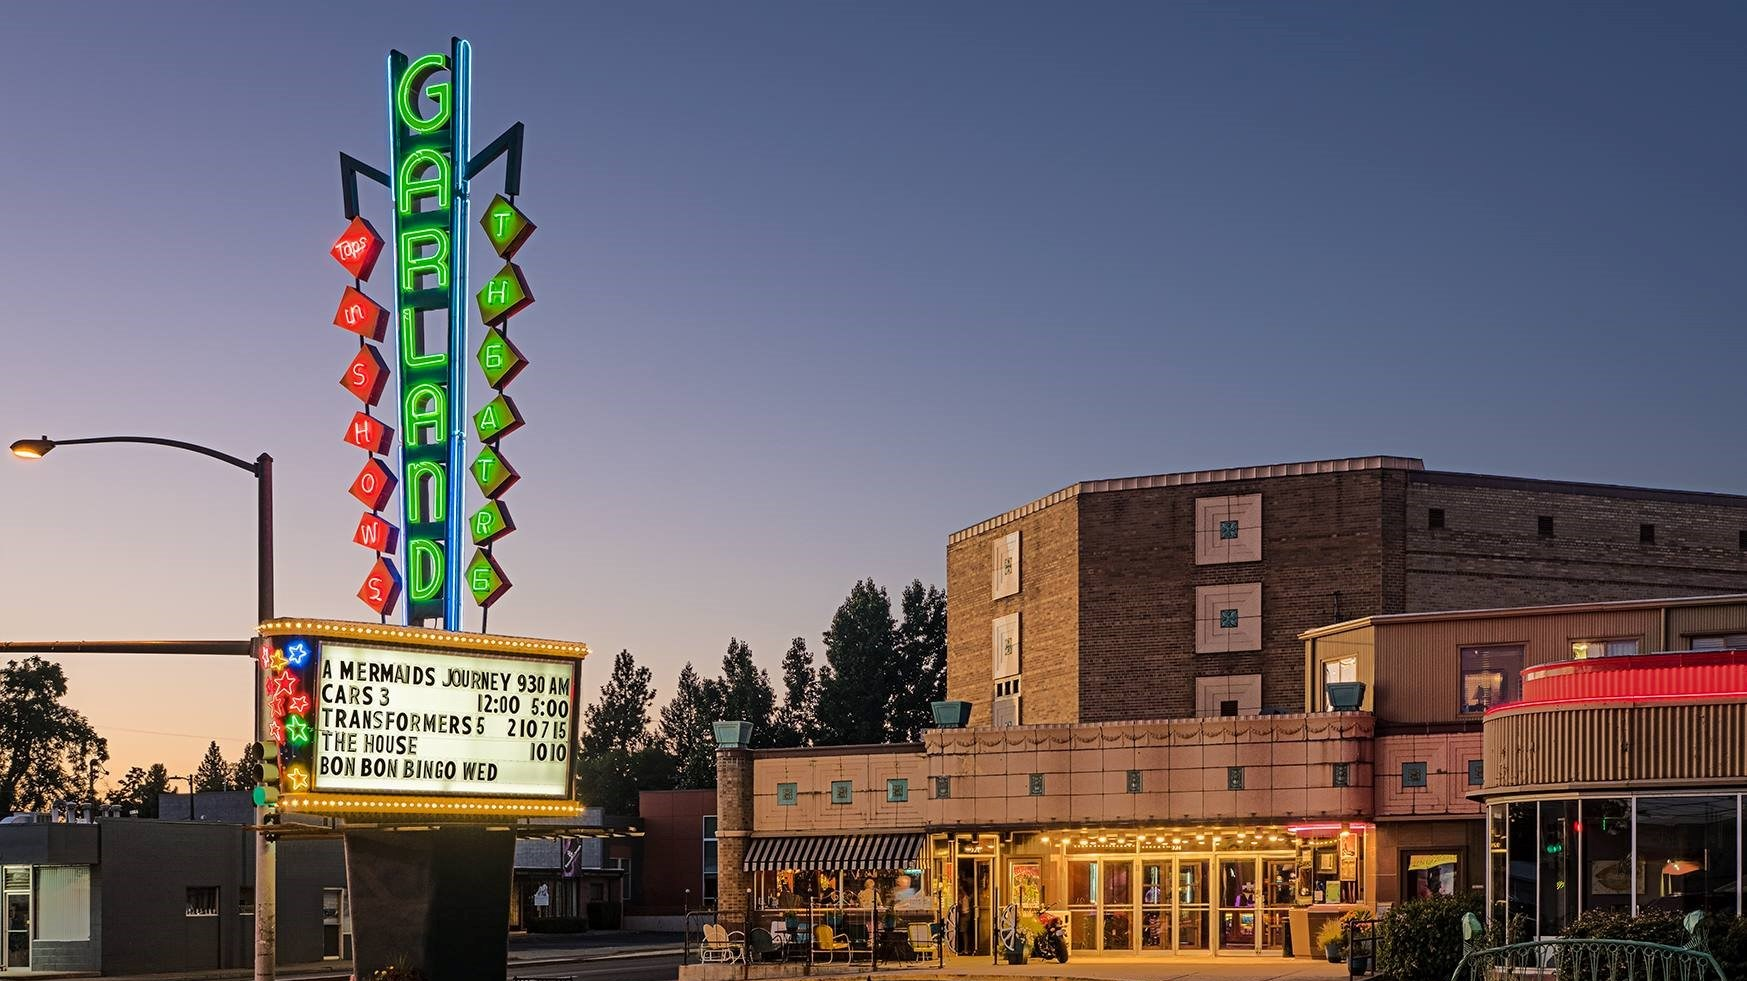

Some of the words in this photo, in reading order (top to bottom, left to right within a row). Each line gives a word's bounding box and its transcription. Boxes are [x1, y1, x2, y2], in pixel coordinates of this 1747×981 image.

[322, 659, 333, 679] A
[340, 660, 436, 687] MERMAIDS
[442, 668, 512, 692] JOURNEY
[517, 674, 546, 694] 930
[549, 676, 570, 696] AM
[321, 683, 374, 706] CARS
[379, 686, 390, 707] 3
[477, 693, 521, 715] 12:00
[531, 697, 569, 719] 5:00
[321, 707, 472, 736] TRANSFORMERS
[321, 730, 358, 753] THE
[364, 733, 418, 756] HOUSE
[320, 756, 356, 777] BON
[361, 758, 398, 779] BON
[402, 759, 457, 781] BINGO
[462, 761, 498, 782] WED
